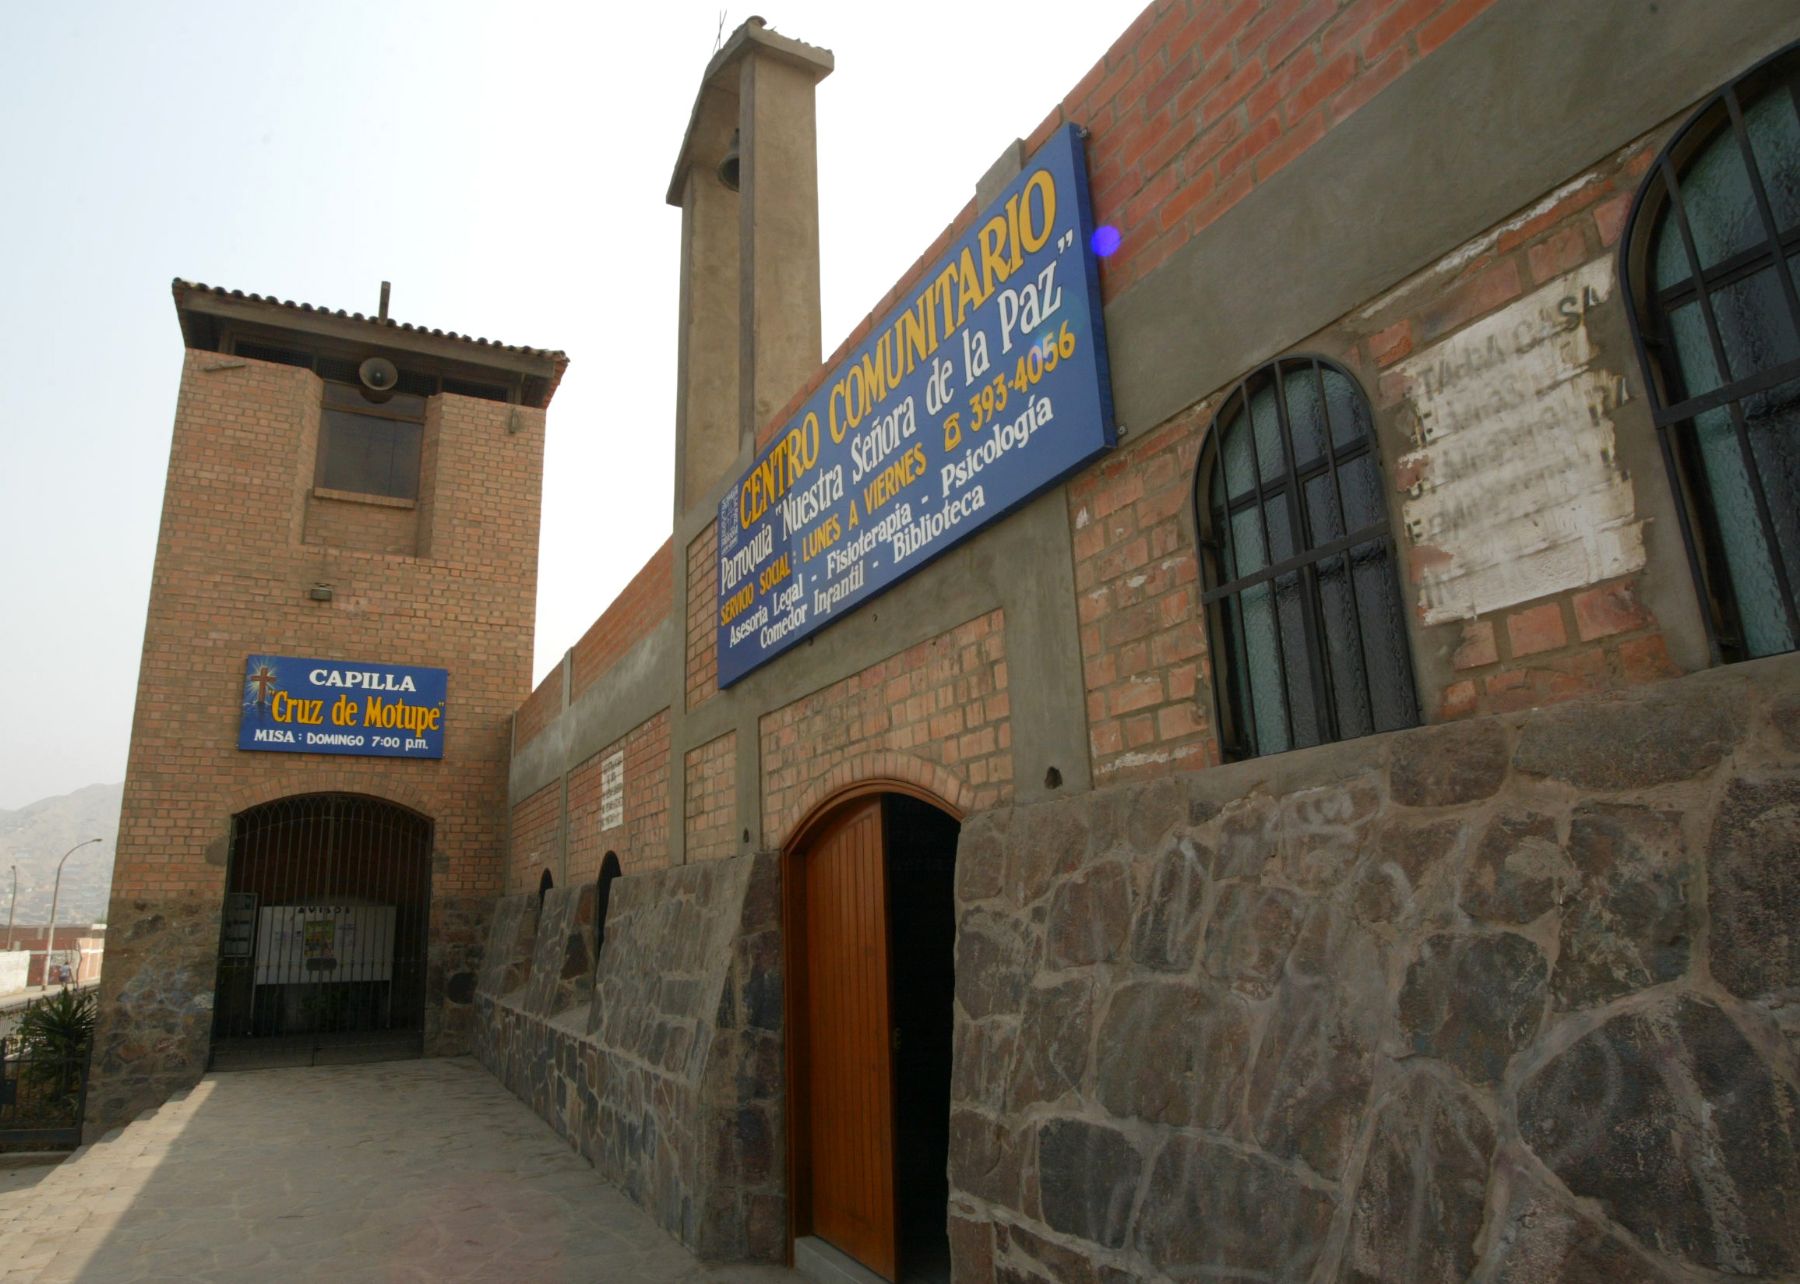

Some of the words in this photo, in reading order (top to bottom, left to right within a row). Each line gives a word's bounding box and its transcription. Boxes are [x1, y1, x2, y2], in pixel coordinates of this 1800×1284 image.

[739, 411, 820, 530] CENTRO
[828, 169, 1056, 444] COMUNITARIO
[720, 582, 755, 627] SERVICIO
[802, 512, 841, 564] LUNES
[848, 499, 859, 531] A
[864, 442, 927, 515] VIERNES
[969, 319, 1076, 432] 393-4056
[721, 523, 772, 596] Parroquia
[851, 395, 917, 485] Señora
[926, 357, 955, 416] de
[961, 327, 991, 388] la
[729, 604, 769, 649] Asesoria
[773, 573, 803, 615] Legal
[826, 502, 912, 580] Fisioterapia
[940, 394, 1054, 498] Psicología
[760, 603, 807, 649] Comedor
[813, 560, 864, 616] Infantil
[893, 484, 986, 563] Biblioteca
[307, 732, 365, 746] DOMINGO
[371, 736, 400, 748] 7:00
[405, 738, 429, 751] p.m.
[309, 669, 416, 692] CAPILLA
[331, 694, 358, 726] de
